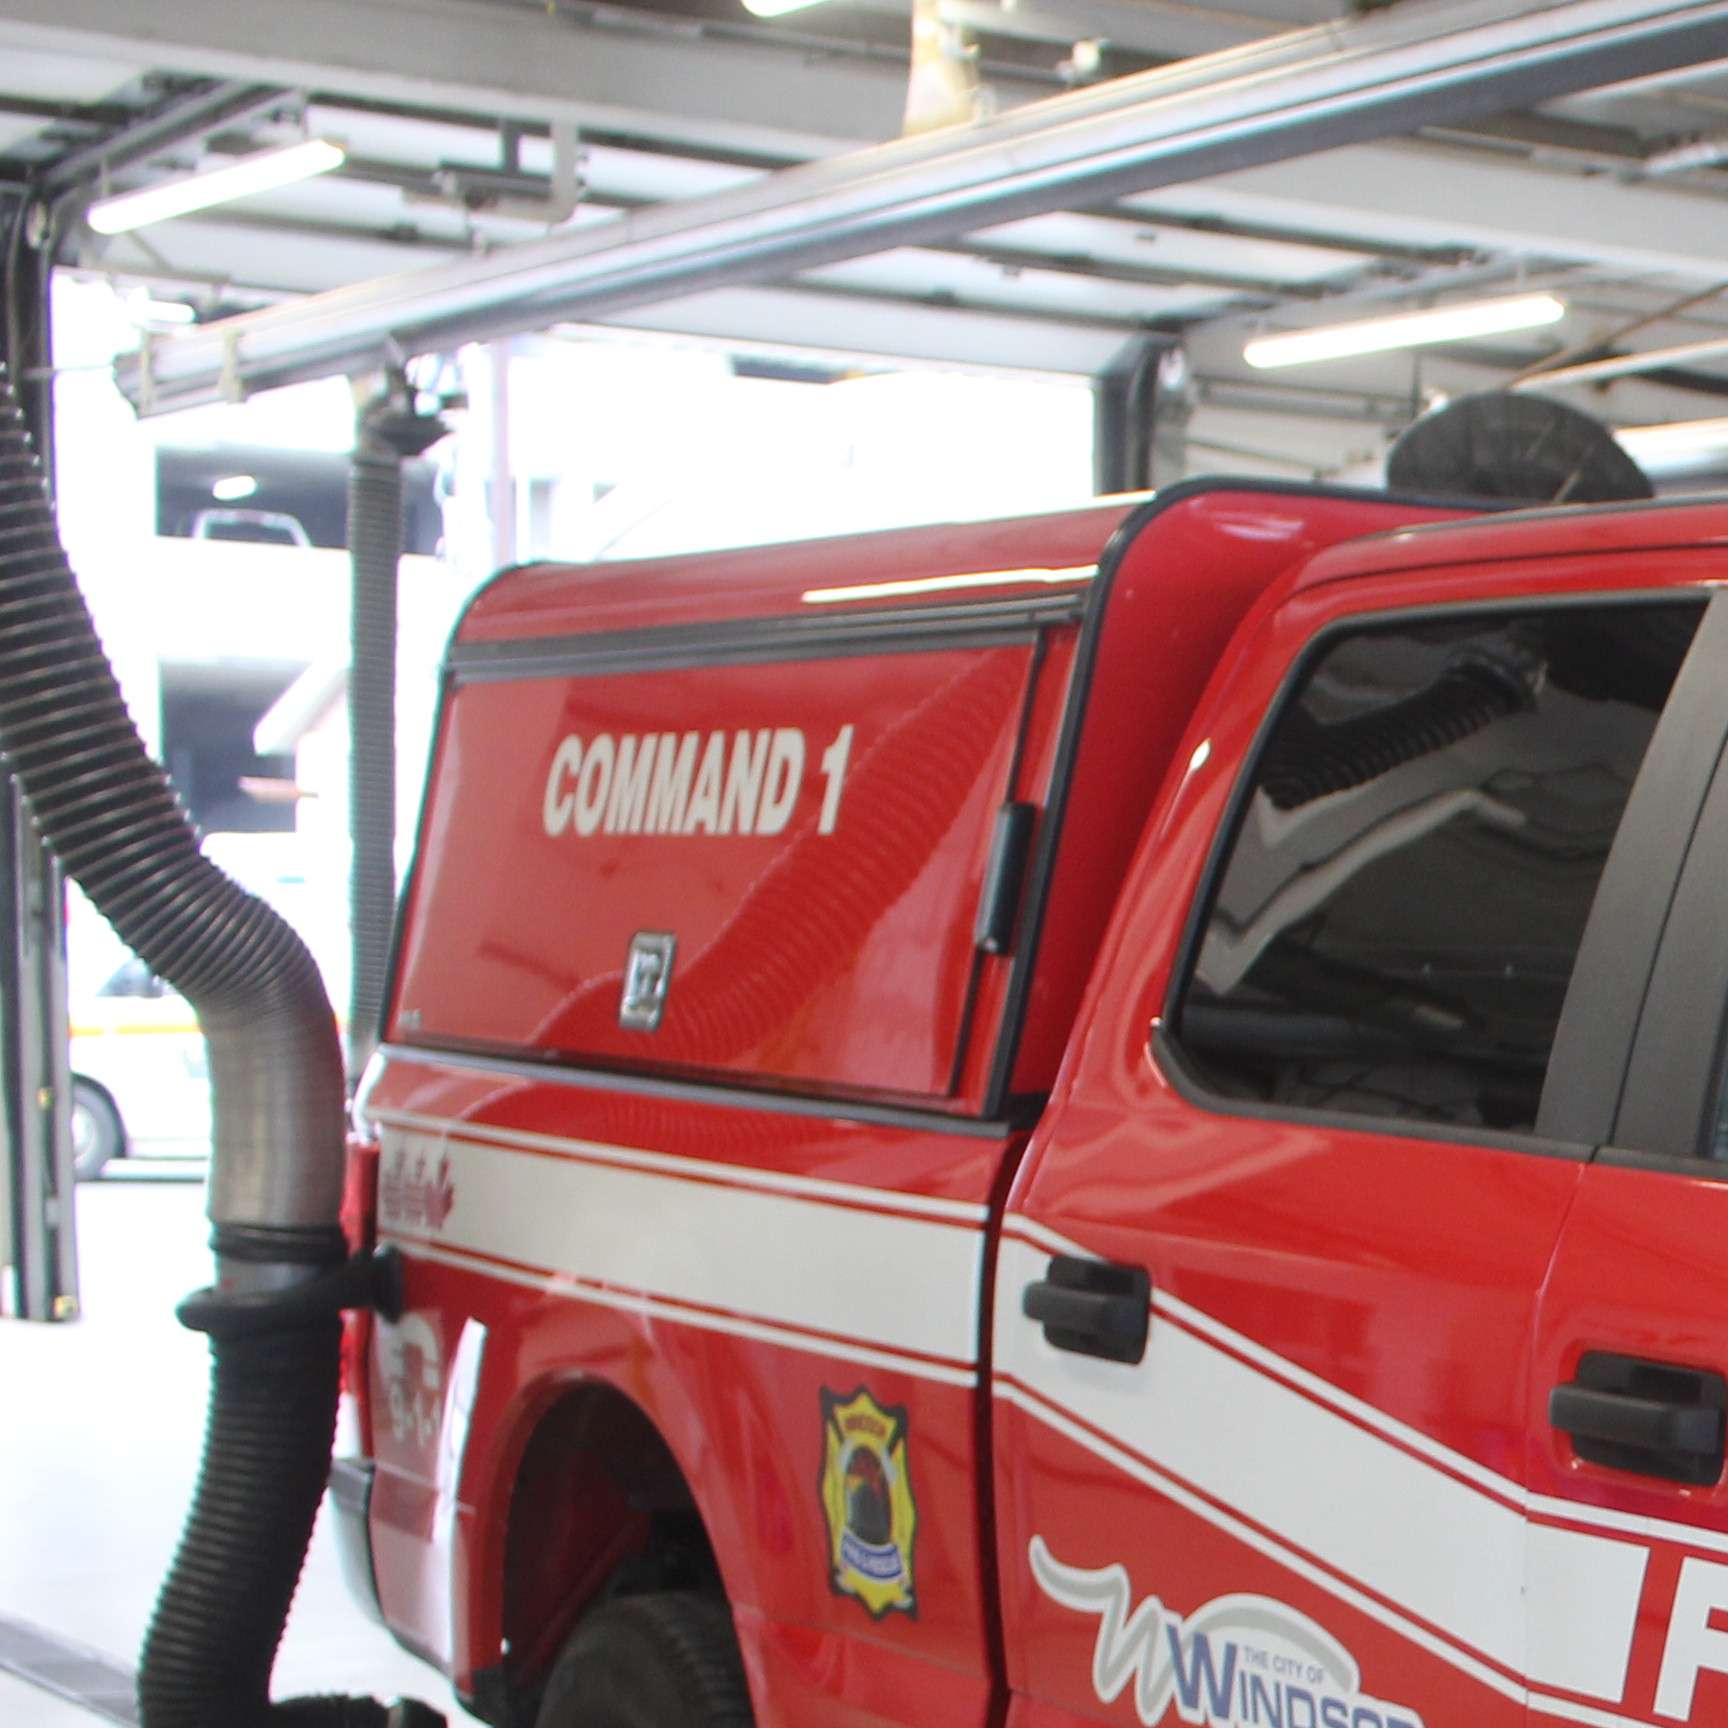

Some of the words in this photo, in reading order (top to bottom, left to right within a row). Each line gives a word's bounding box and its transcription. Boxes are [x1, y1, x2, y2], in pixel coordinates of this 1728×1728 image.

[543, 727, 806, 838] COMMAND
[817, 724, 855, 836] 1
[1243, 1646, 1269, 1667] THE
[1272, 1655, 1304, 1676] CITY
[1306, 1665, 1325, 1685] OF
